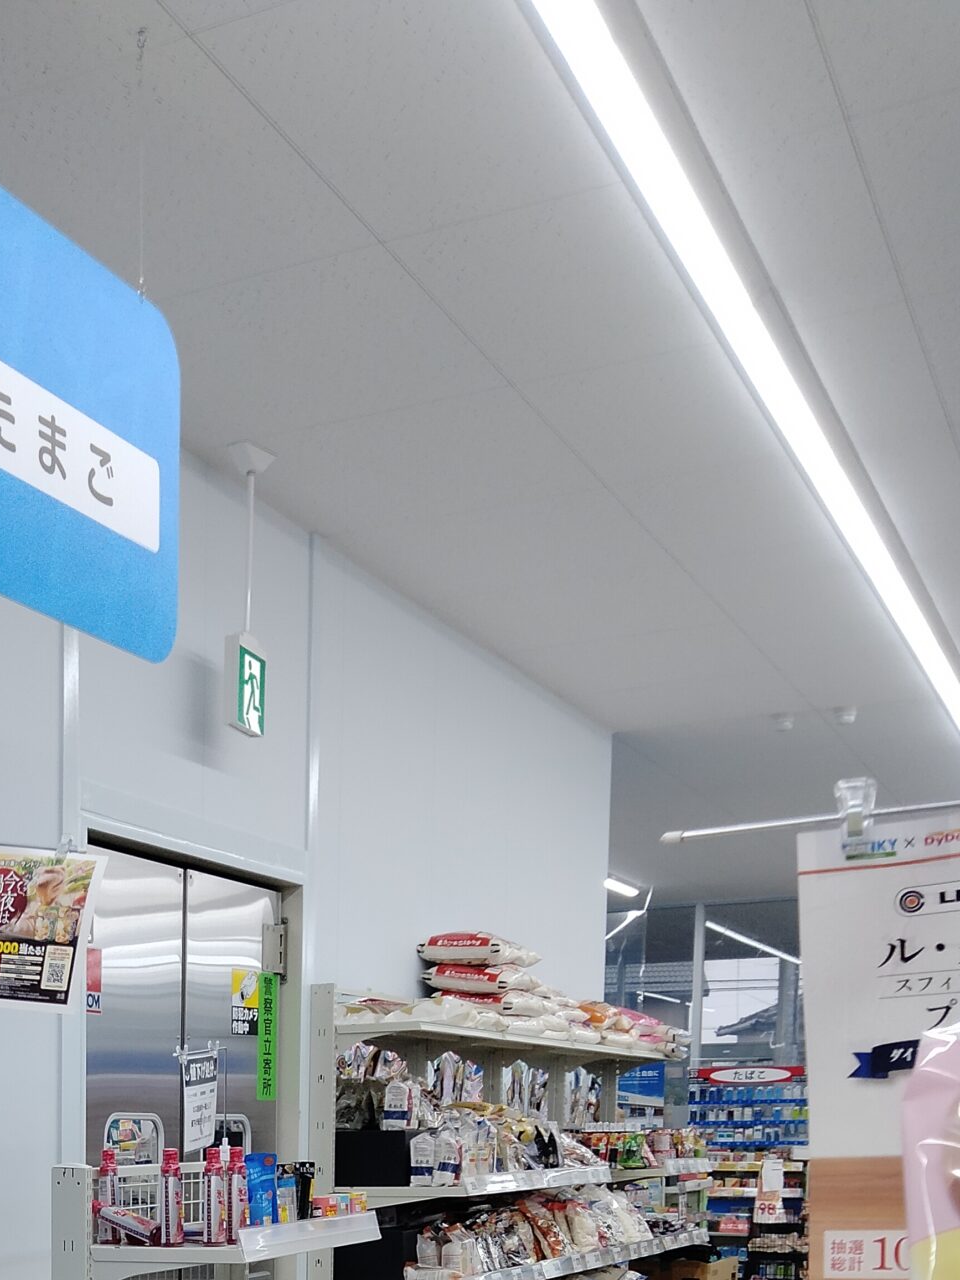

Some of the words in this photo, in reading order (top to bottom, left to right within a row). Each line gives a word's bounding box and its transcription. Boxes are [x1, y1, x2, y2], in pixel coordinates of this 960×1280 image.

[262, 976, 274, 1096] 警察官立寄所
[733, 1068, 767, 1081] たばこ
[830, 1240, 864, 1255] 抽選
